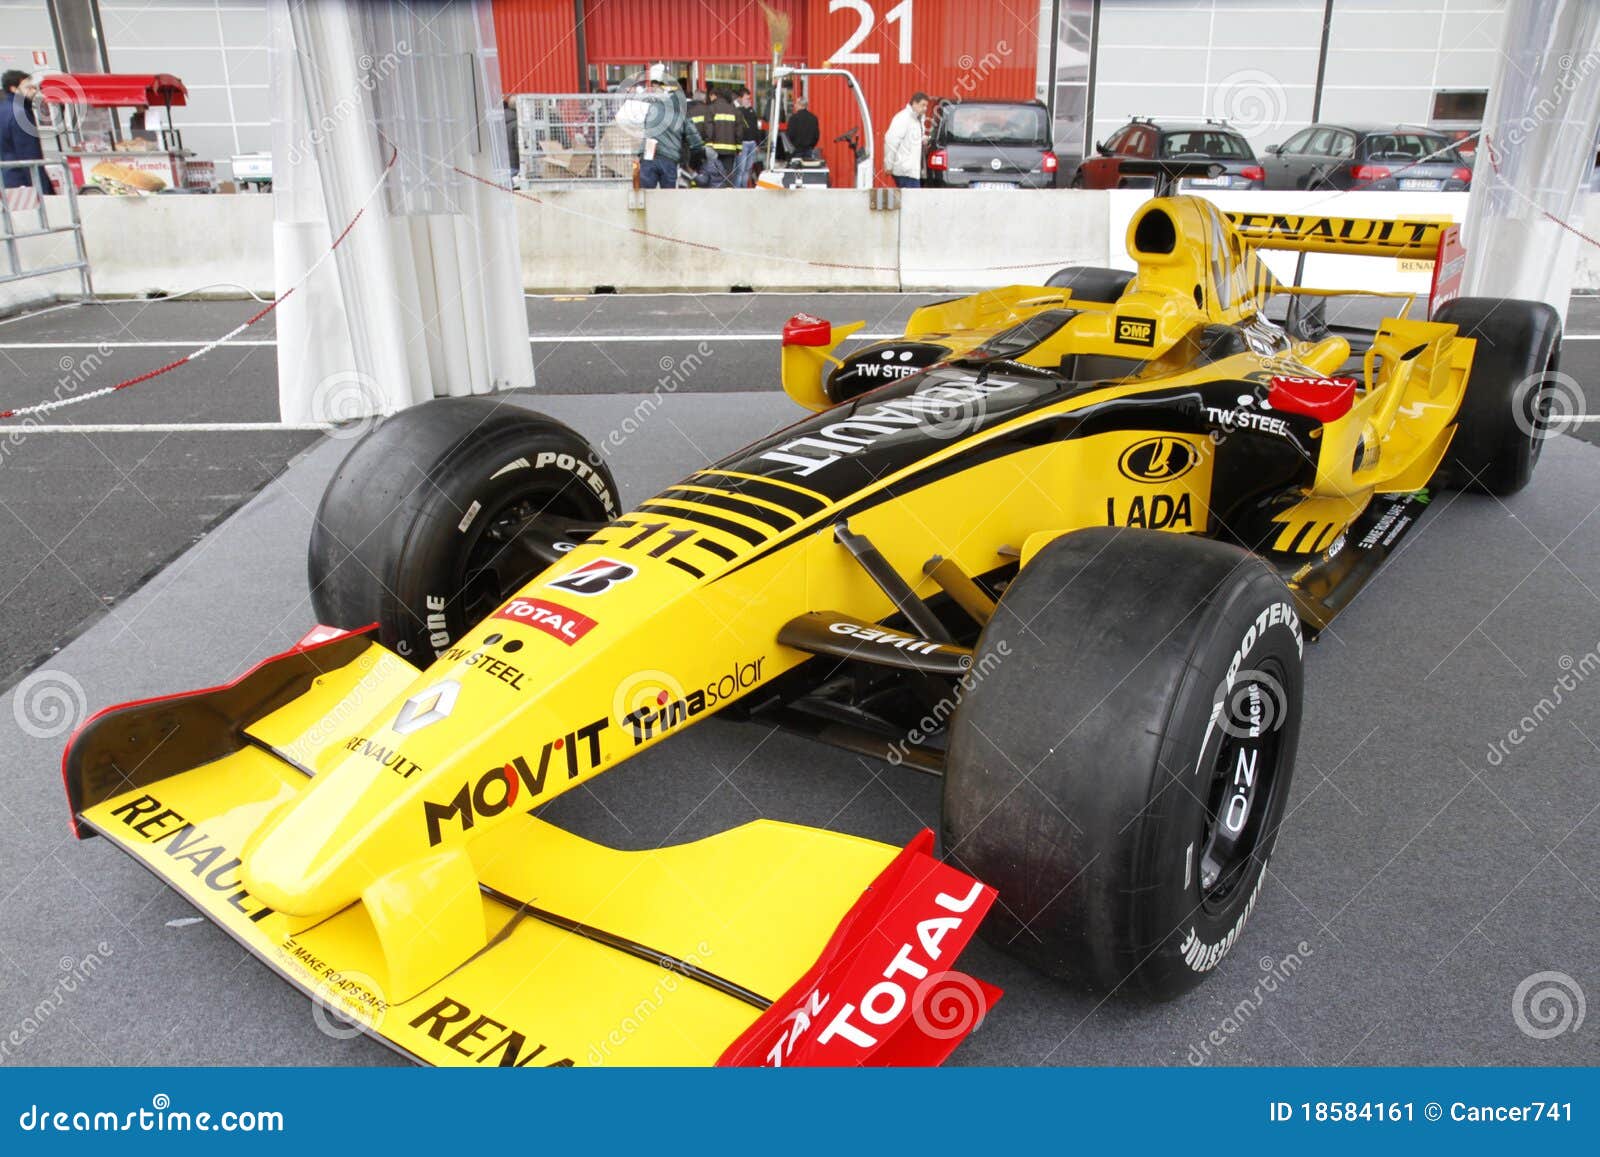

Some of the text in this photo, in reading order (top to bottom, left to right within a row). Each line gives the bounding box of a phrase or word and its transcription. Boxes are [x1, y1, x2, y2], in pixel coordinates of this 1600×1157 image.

[829, 0, 912, 64] 21
[1120, 323, 1151, 339] OMP
[856, 364, 880, 377] TW
[1275, 375, 1349, 387] TOTAL
[1207, 407, 1287, 437] TW STEEL
[620, 522, 698, 559] 11
[504, 600, 578, 638] TOTAL
[465, 652, 525, 691] STEEL
[1248, 683, 1262, 738] RACING
[344, 736, 422, 778] RENAULT
[293, 946, 391, 1012] MAKE ROADS SAFE
[816, 882, 984, 1048] TOTAL
